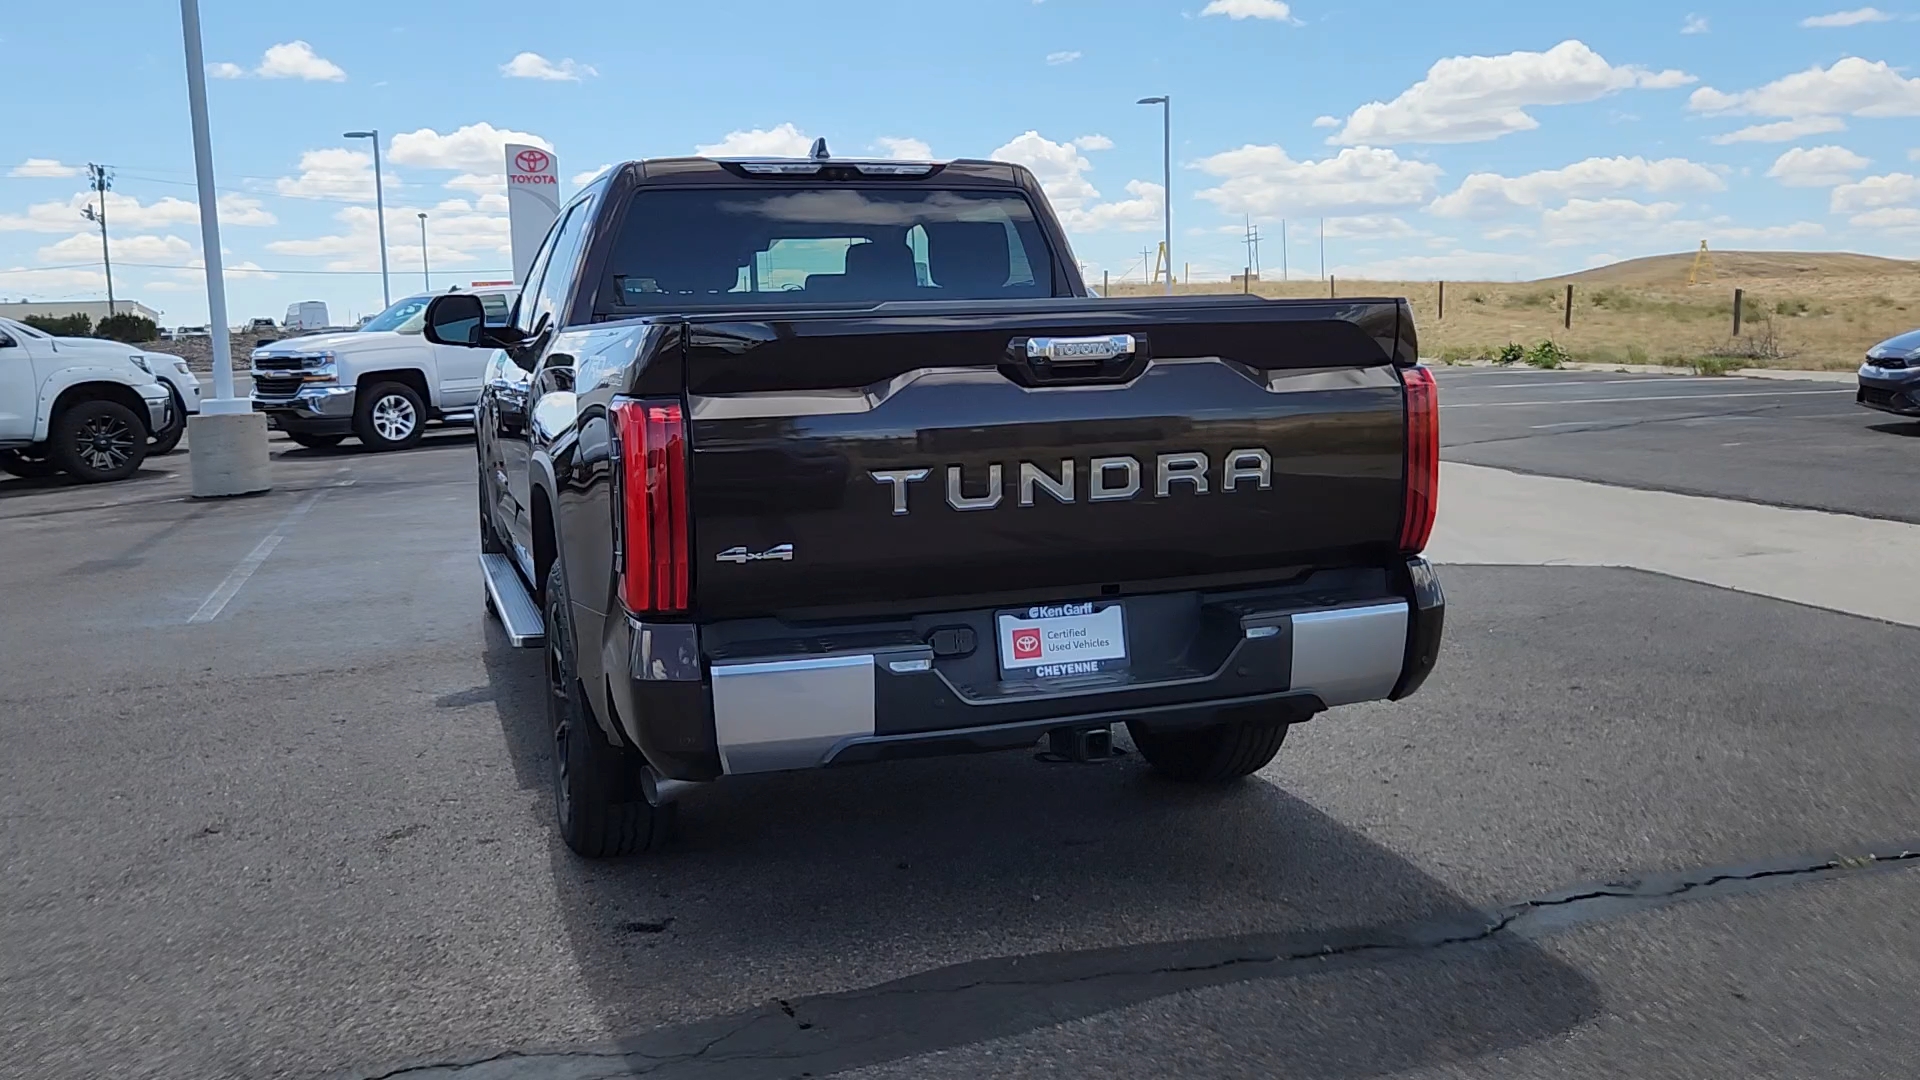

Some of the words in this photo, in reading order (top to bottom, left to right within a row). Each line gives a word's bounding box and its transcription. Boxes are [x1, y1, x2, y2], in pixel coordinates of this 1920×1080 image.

[510, 175, 557, 184] TOYOTA
[1057, 343, 1107, 356] TOYOTA
[868, 448, 1274, 515] TUNDRA
[716, 544, 793, 564] 4x4
[1040, 606, 1063, 618] Ken
[1063, 602, 1093, 615] Garff
[1047, 628, 1087, 640] Certified
[1048, 642, 1071, 652] Used
[1073, 638, 1110, 650] Vehicles
[1035, 661, 1099, 677] CHEYENNE
